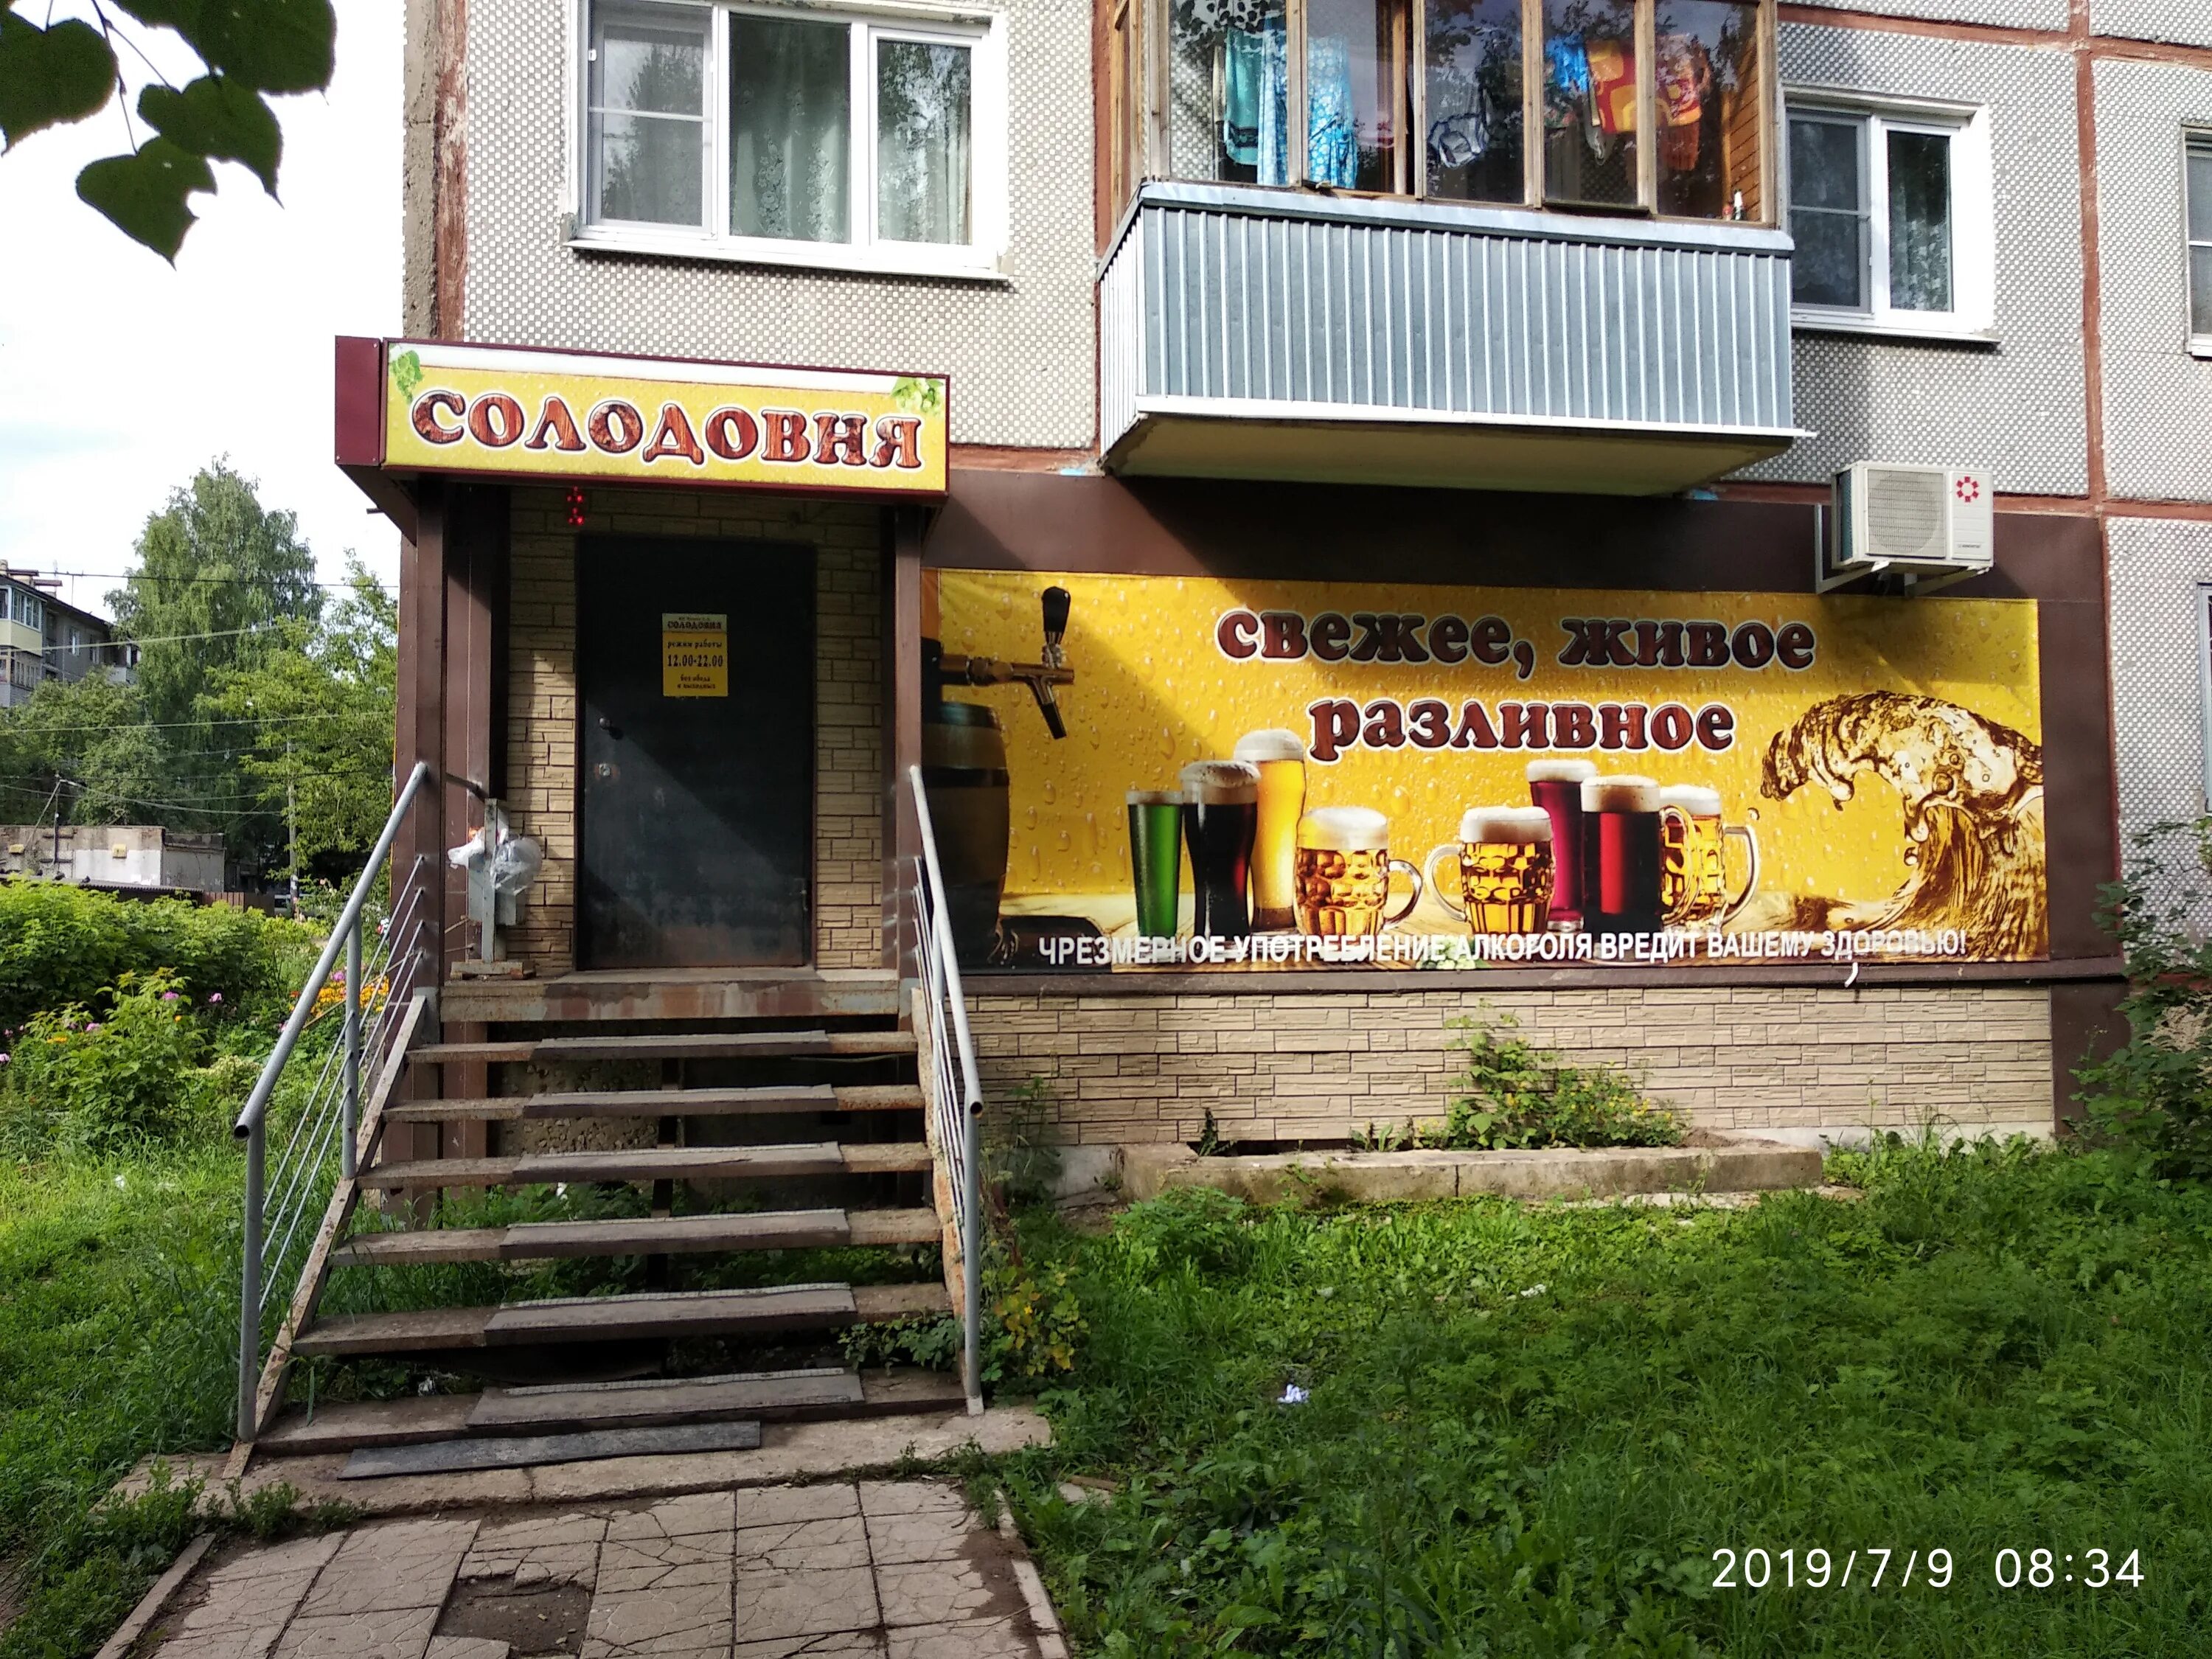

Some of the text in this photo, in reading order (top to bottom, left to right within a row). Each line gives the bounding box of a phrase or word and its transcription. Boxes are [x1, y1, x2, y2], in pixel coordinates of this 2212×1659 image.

[410, 388, 923, 470] СОЛОДОВНЯ
[667, 654, 723, 667] 12.00-22.00
[1216, 609, 1816, 679] свежее, живое
[1308, 698, 1736, 762] разливное
[1038, 929, 1966, 965] ЧРЕЗМЕРНОЕ УПОТРЕБЛЕНИЕ АЛКОГОЛЯ ВРЕДИТ ВАШЕМУ ЗДОРОВЬЮ!
